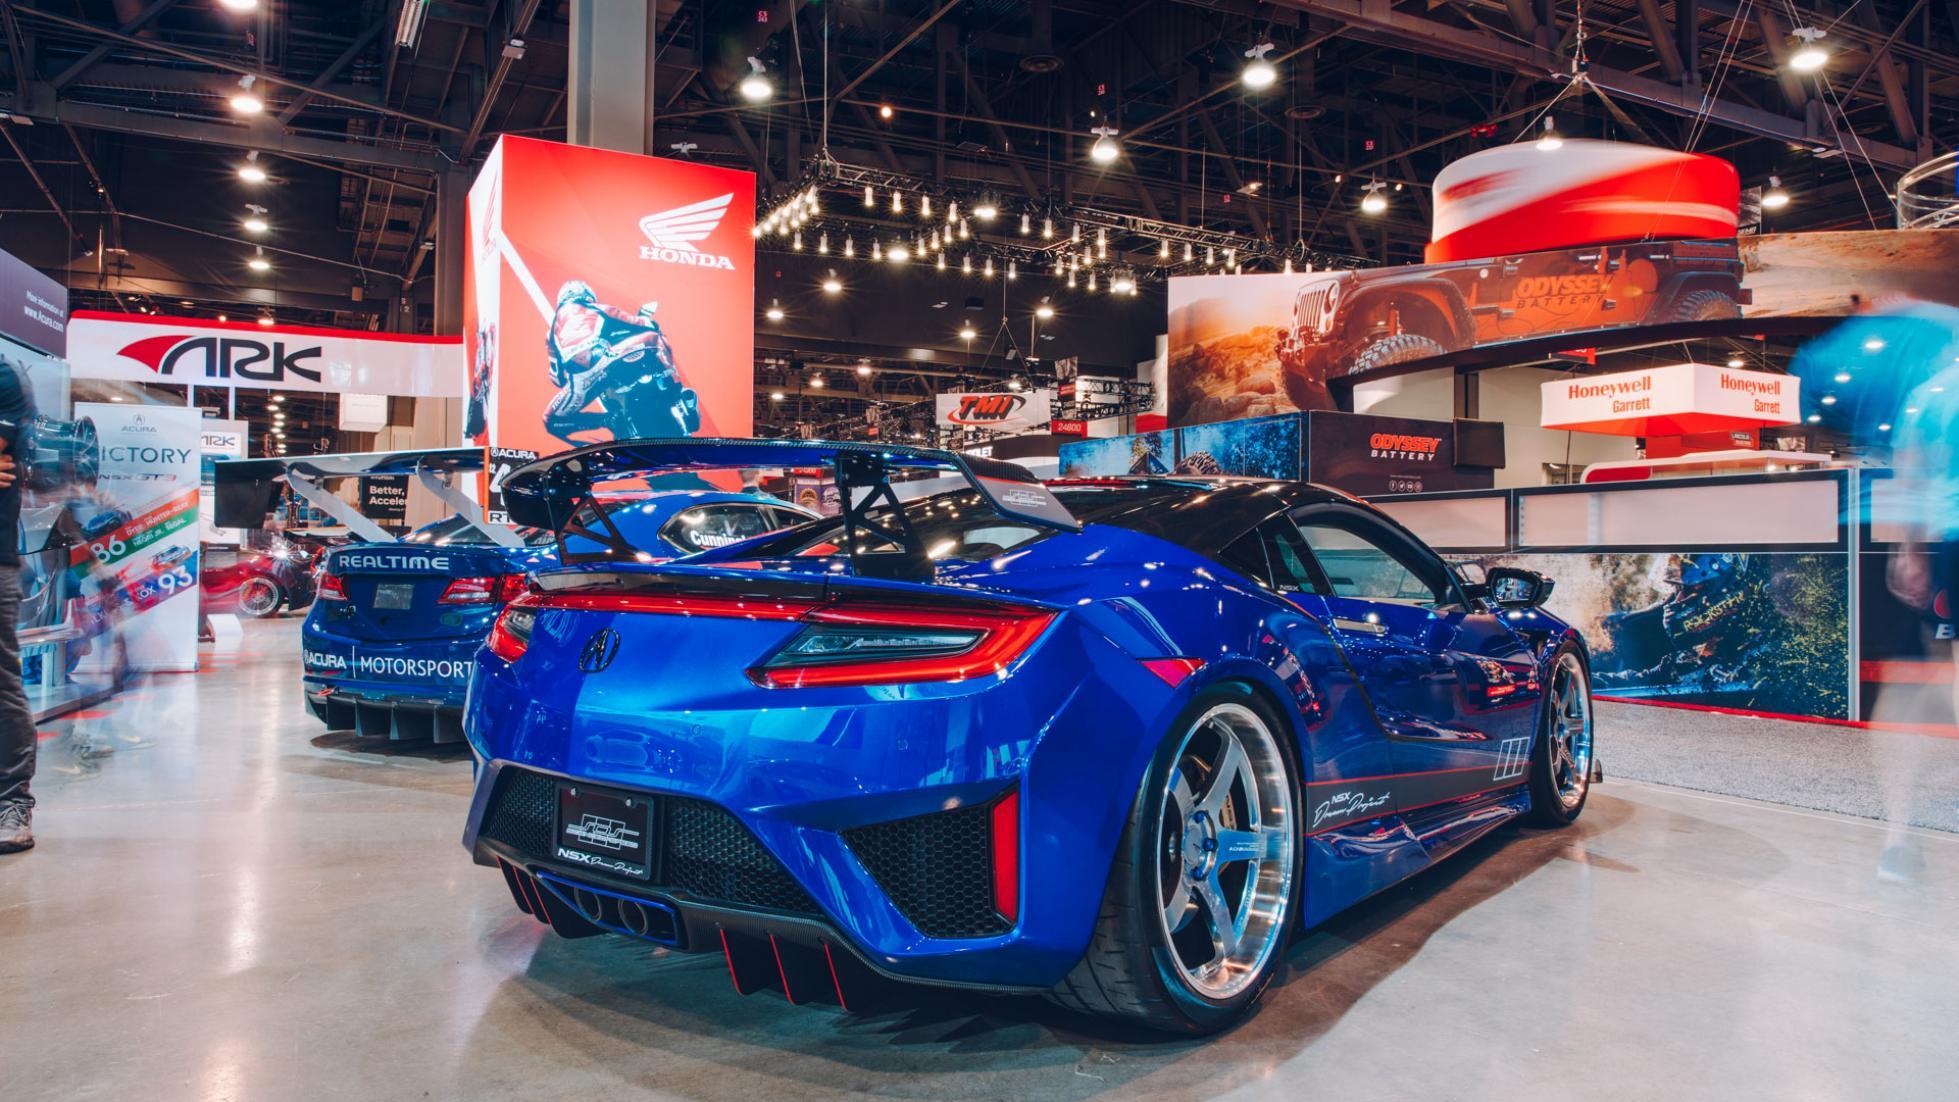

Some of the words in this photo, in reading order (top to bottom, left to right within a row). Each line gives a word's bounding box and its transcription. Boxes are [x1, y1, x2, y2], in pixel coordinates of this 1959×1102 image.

[639, 245, 735, 271] HONDA
[1516, 275, 1614, 299] ODYSSEY
[1517, 294, 1605, 309] BATTERY
[161, 336, 322, 384] ARK
[1568, 376, 1651, 400] Honeywell
[1720, 373, 1781, 396] Honeywell
[958, 395, 1014, 420] TMI
[1612, 397, 1651, 414] Garrett
[1754, 398, 1781, 414] Garrett
[120, 425, 157, 433] ACURA
[1370, 433, 1439, 453] ODYSSEY
[102, 445, 192, 464] ICTORY
[499, 448, 537, 460] ACURA
[1370, 450, 1435, 461] BATTERY
[369, 485, 405, 496] Better,
[90, 534, 126, 563] 86
[339, 555, 449, 570] REALTIME
[157, 565, 193, 595] 93
[308, 652, 347, 669] ACURA
[360, 655, 473, 679] MOTORSPORT
[1331, 792, 1351, 804] NSX
[557, 848, 591, 863] NSX
